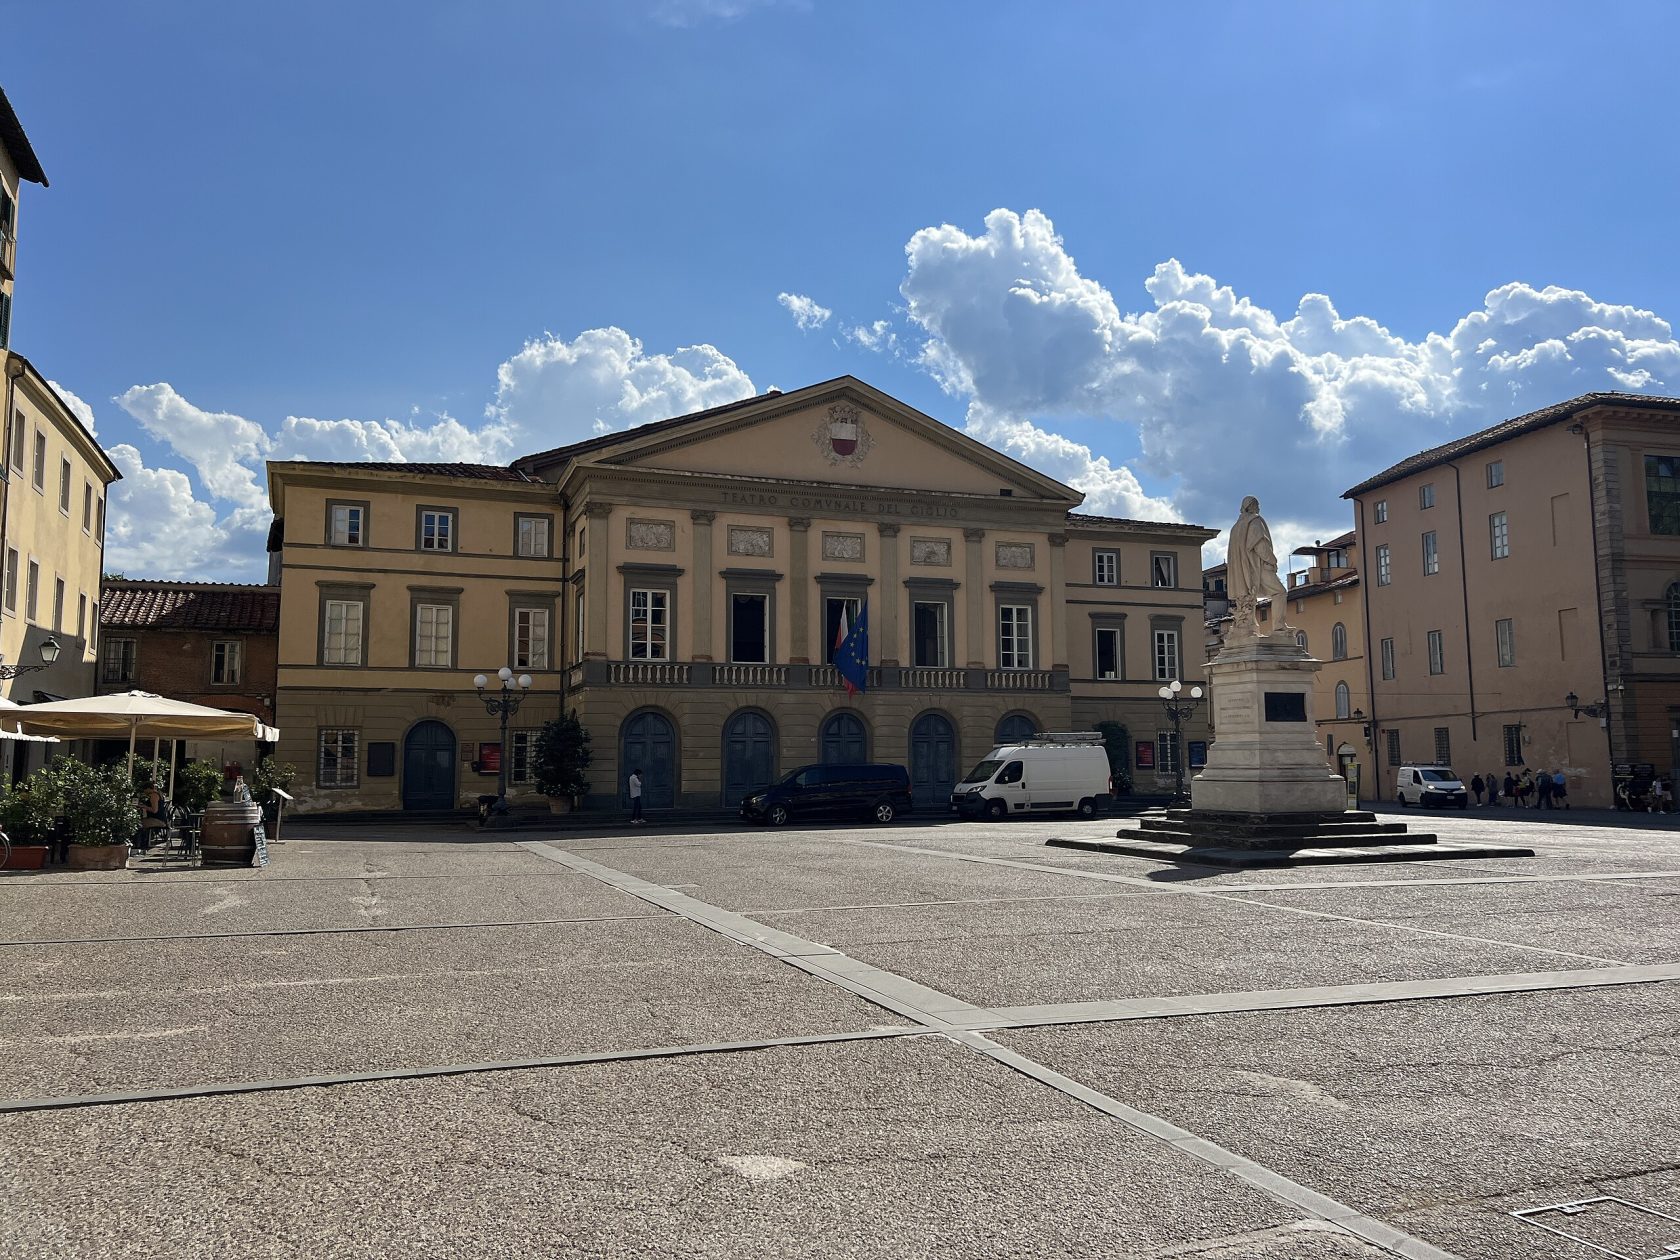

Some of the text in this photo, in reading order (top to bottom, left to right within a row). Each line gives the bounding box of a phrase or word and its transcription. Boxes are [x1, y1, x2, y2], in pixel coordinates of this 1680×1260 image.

[721, 492, 958, 517] TEATRO COMVNALE DEL GIGLIO
